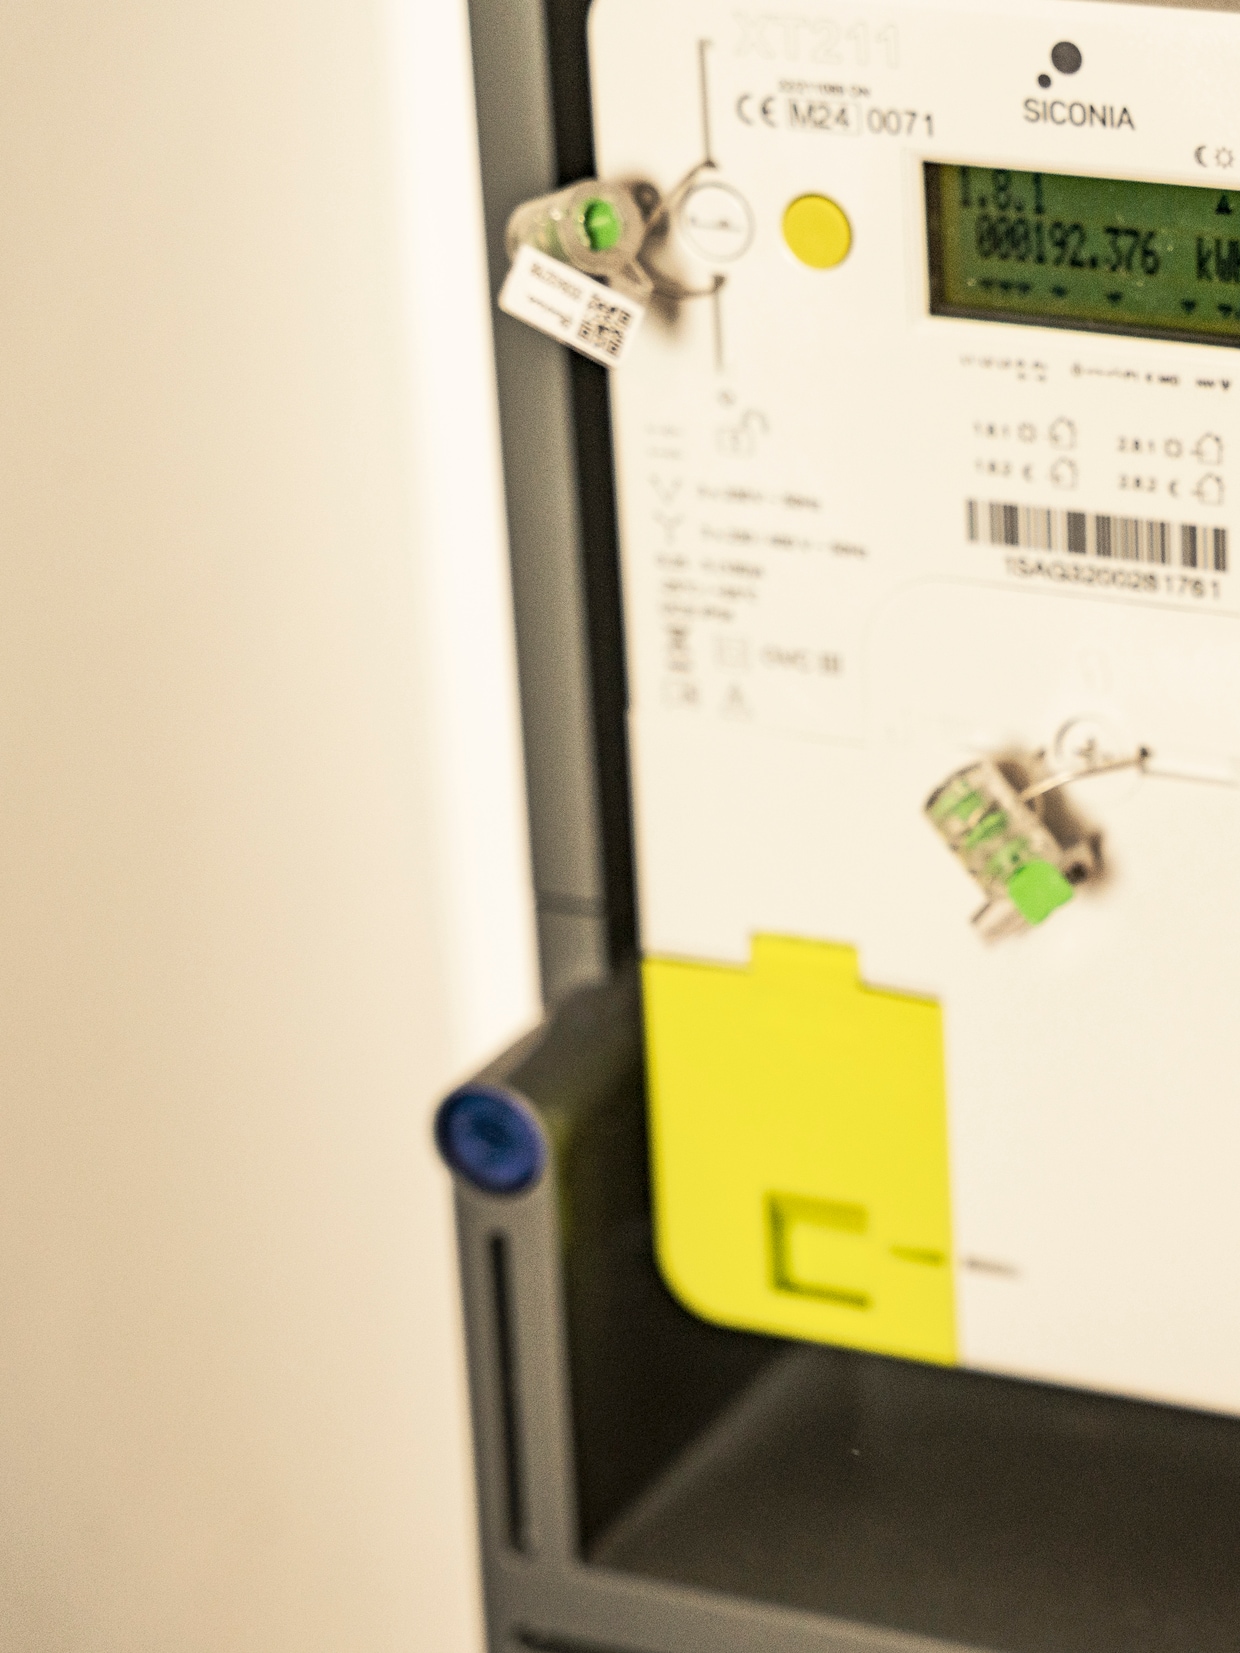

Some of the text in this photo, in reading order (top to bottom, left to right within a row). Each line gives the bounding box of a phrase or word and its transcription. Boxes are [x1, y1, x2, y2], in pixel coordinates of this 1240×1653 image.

[790, 101, 850, 131] M24
[867, 106, 935, 138] 0071
[1023, 98, 1135, 131] SICONIA
